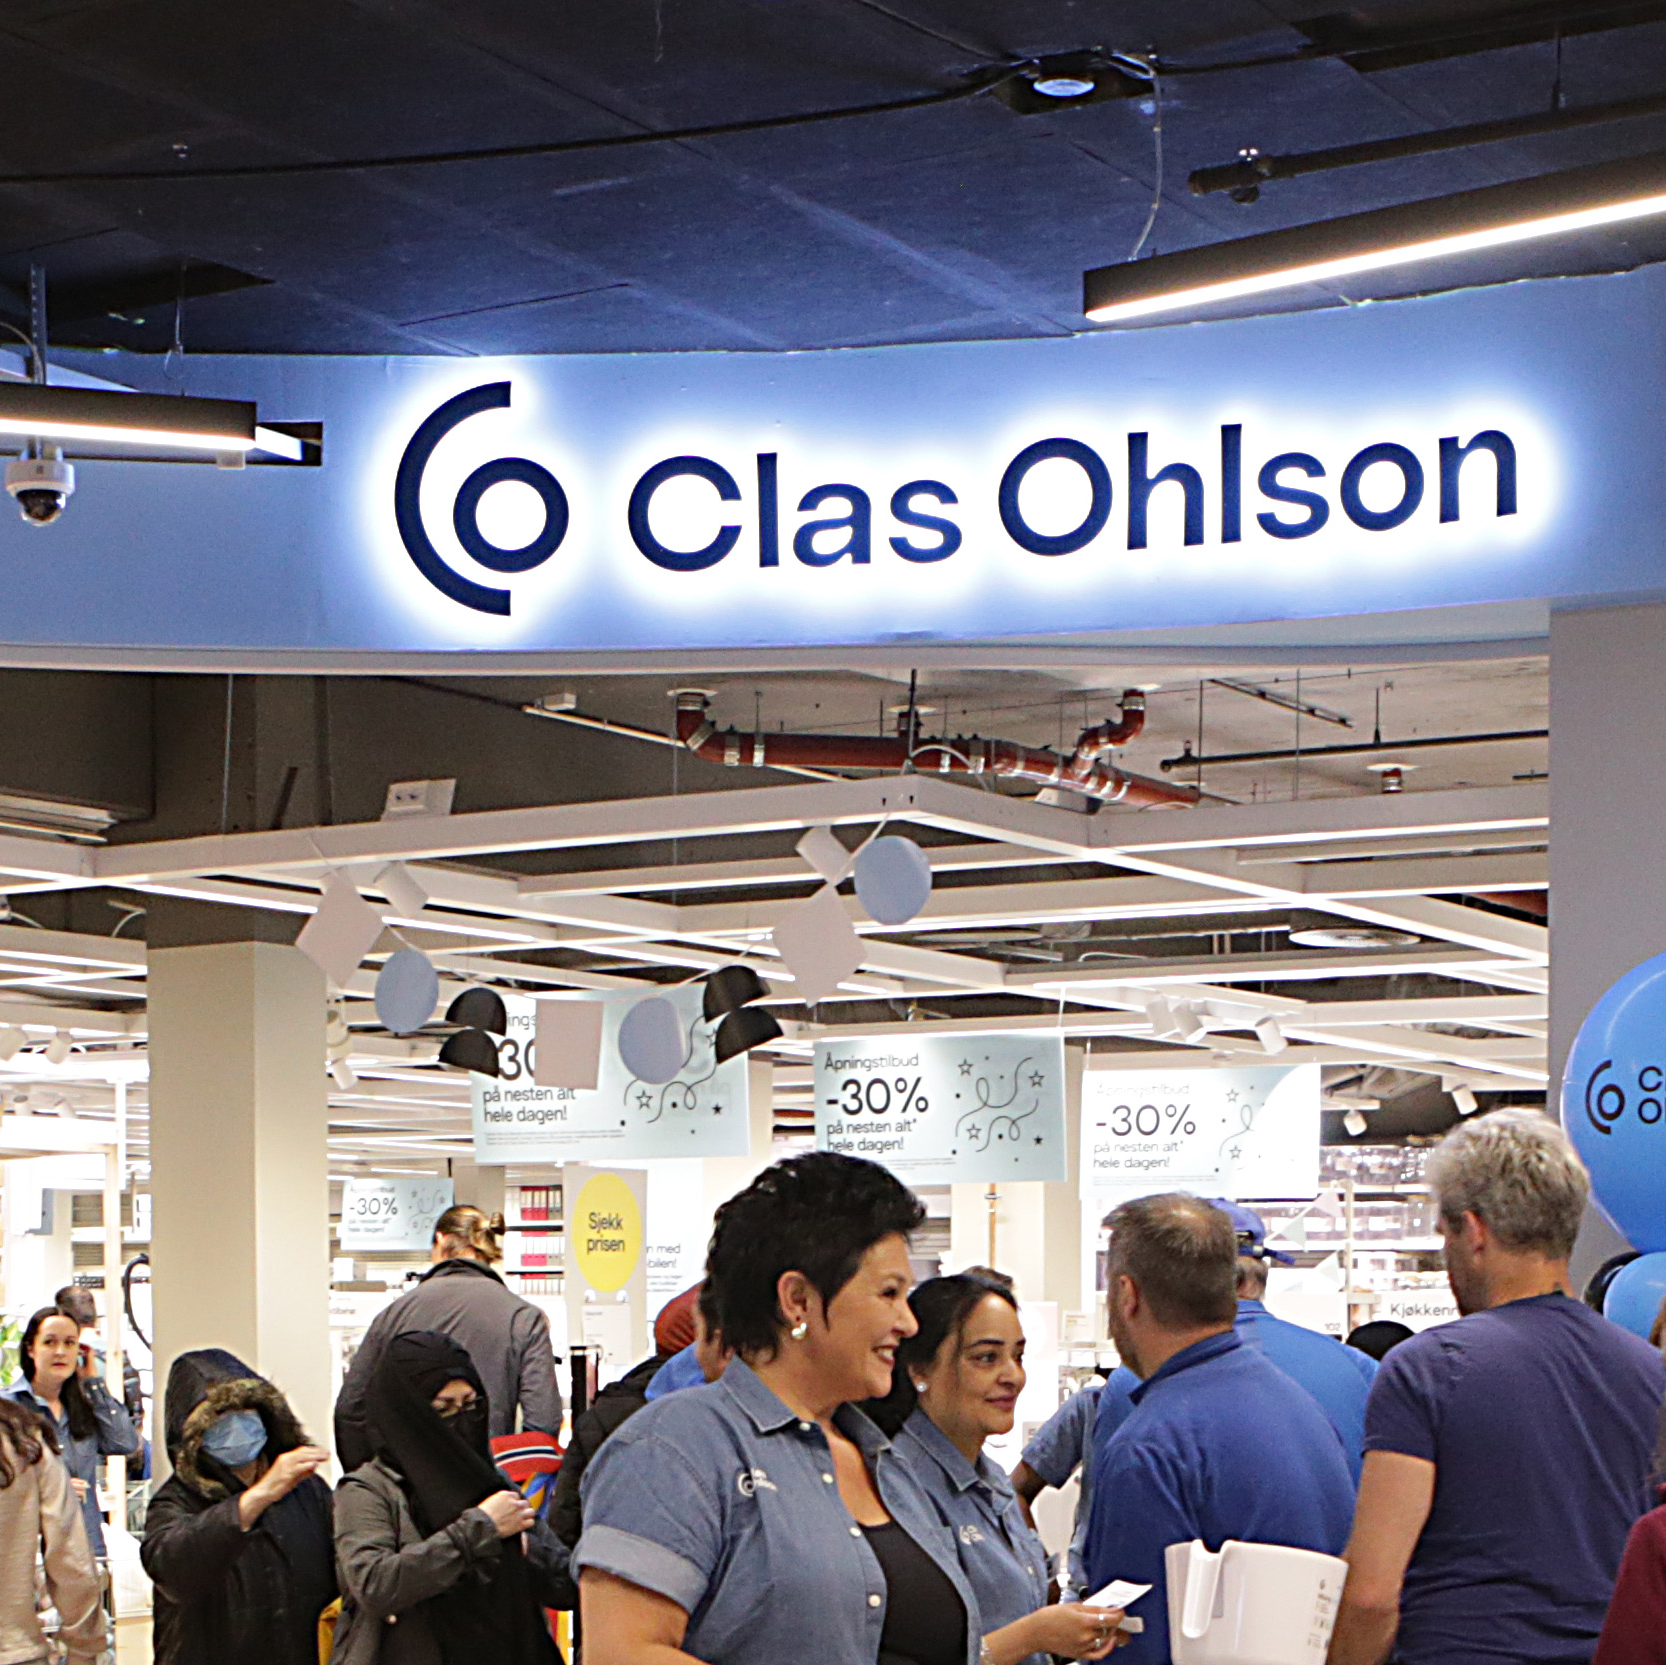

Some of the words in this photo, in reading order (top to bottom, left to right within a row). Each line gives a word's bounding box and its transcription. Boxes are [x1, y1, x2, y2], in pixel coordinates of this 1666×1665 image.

[626, 451, 963, 572] Clas
[997, 422, 1518, 556] Ohlson
[824, 1052, 920, 1072] Åpningstilbud
[482, 1084, 501, 1106] på
[504, 1087, 554, 1102] nesten
[557, 1087, 576, 1100] alt
[825, 1076, 929, 1116] -30%
[484, 1106, 513, 1123] hele
[516, 1105, 568, 1125] dagen!
[1095, 1103, 1197, 1137] -30%
[826, 1119, 843, 1135] på
[846, 1121, 893, 1134] nesten
[826, 1136, 855, 1152] hele
[857, 1136, 905, 1154] dagen!
[1093, 1140, 1111, 1155] på
[1114, 1142, 1159, 1153] nesten
[1093, 1157, 1120, 1169] hele
[1124, 1156, 1170, 1171] dagen!
[349, 1197, 399, 1216] -30%
[588, 1211, 624, 1235] Sjekk
[586, 1233, 626, 1255] prisen
